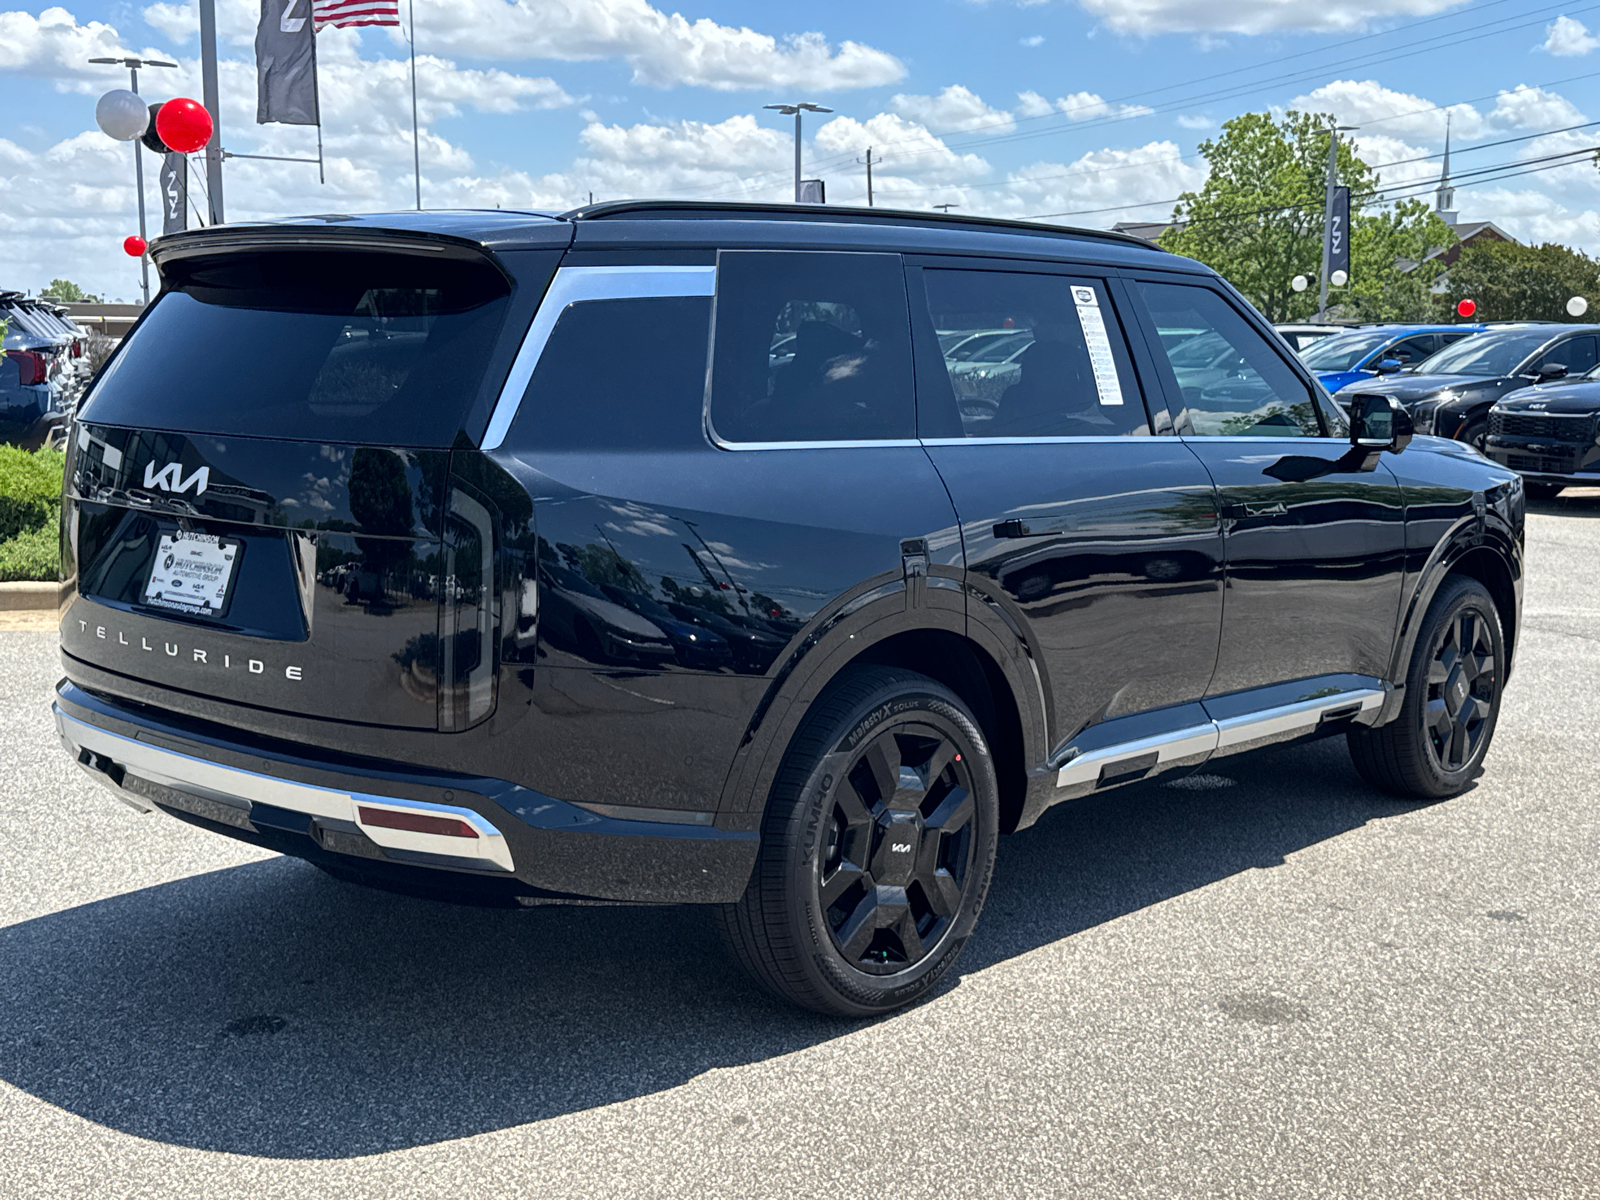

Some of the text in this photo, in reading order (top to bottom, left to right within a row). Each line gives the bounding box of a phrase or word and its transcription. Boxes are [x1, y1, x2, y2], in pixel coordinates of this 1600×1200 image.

[143, 459, 210, 496] KIA
[182, 531, 220, 545] HUTCHINSON
[78, 619, 303, 681] TELLURIDE
[893, 701, 919, 712] SOLUS
[802, 773, 833, 867] KUMHO
[891, 842, 912, 853] KIA
[972, 832, 997, 917] KUMHO
